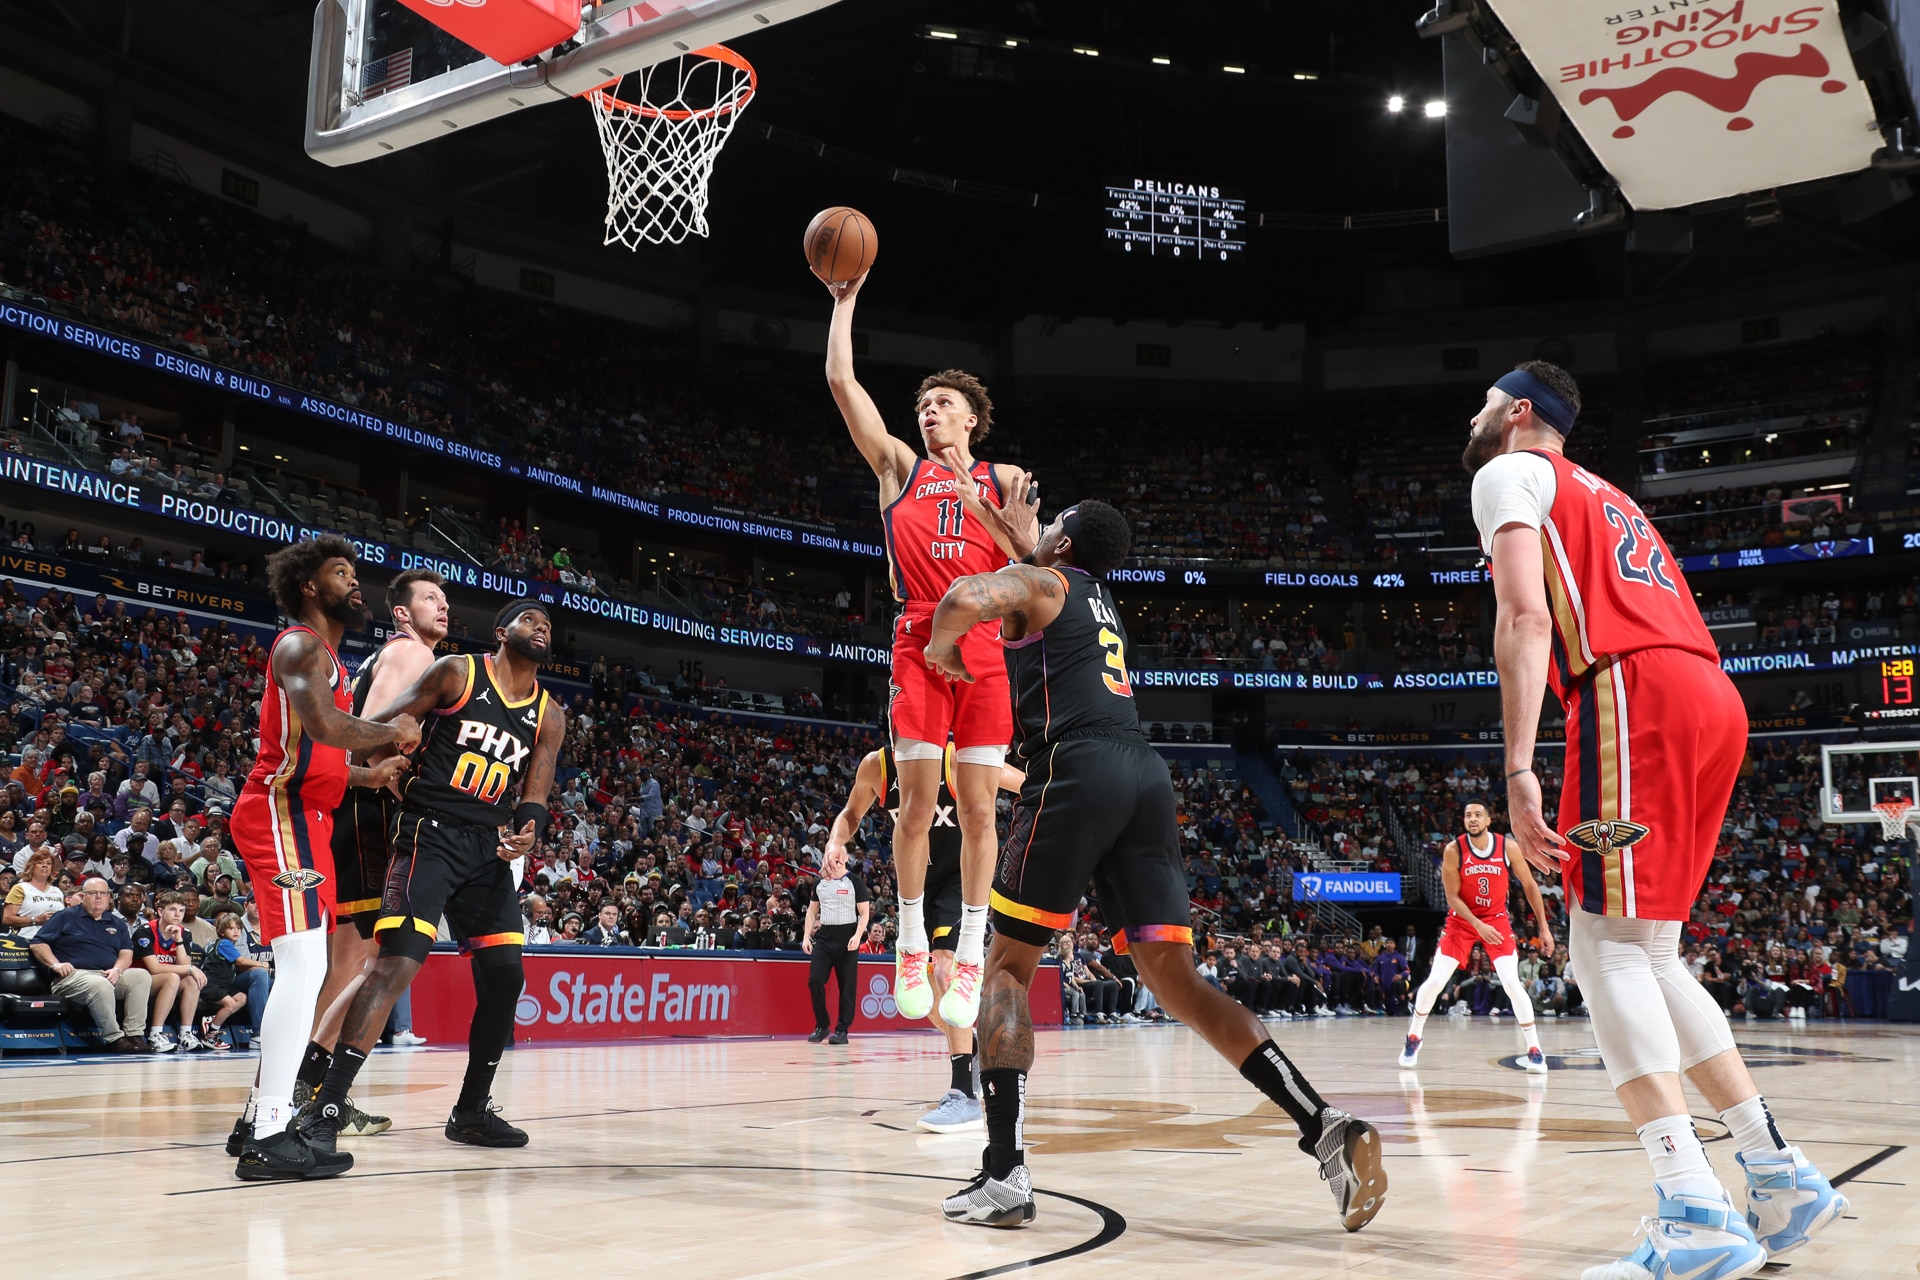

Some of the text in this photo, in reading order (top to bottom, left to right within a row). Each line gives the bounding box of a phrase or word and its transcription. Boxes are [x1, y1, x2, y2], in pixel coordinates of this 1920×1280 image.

[1560, 6, 1824, 83] SMOOTHIE
[1134, 179, 1219, 199] PELICANS
[1119, 199, 1140, 211] 42%
[1169, 204, 1184, 215] 0%
[1213, 208, 1234, 220] 44%
[1124, 221, 1130, 230] 1
[1173, 225, 1180, 235] 4
[1220, 230, 1227, 240] 5
[1124, 242, 1131, 252] 6
[1173, 246, 1180, 256] 0
[1220, 250, 1227, 261] 0
[63, 324, 141, 361] SERVICES
[155, 352, 271, 400] DESIGN & BUILD
[300, 396, 502, 469] ASSOCIATED BUILDING SERVICES
[526, 465, 584, 494] JANITORIAL
[591, 485, 660, 517] MAINTENANCE
[161, 494, 294, 544] PRODUCTION
[668, 508, 794, 542] PRODUCTION SERVICES
[936, 499, 965, 537] 11
[802, 532, 883, 557] DESIGN & BUILD
[931, 541, 966, 559] CITY
[1709, 554, 1720, 568] 4
[1738, 555, 1765, 567] FOULS
[1739, 549, 1762, 559] TEAM
[466, 569, 477, 586] &
[482, 571, 528, 598] BUILD
[1184, 571, 1206, 585] 0%
[1265, 573, 1405, 588] FIELD GOALS 42%
[1430, 570, 1480, 584] THREE
[137, 582, 245, 612] BETRIVERS
[561, 591, 794, 652] ASSOCIATED BUILDING SERVICES
[1711, 608, 1749, 621] CLUB
[828, 643, 893, 665] JANITORI
[1099, 627, 1134, 698] 3
[1718, 653, 1815, 673] ANITORIAL
[1881, 660, 1914, 677] 1:28
[1144, 671, 1219, 687] SERVICES
[1234, 673, 1358, 690] DESIGN & BUILD
[1393, 671, 1499, 689] ASSOCIATED
[1882, 676, 1913, 705] 13
[1430, 702, 1456, 723] 117
[1880, 708, 1920, 718] TISSOT
[456, 719, 530, 772] PHX
[1347, 732, 1430, 743] BETRIVERS
[450, 751, 511, 806] 00
[1464, 863, 1503, 876] CRESCENT
[1325, 879, 1394, 895] FANDUEL
[1477, 876, 1490, 896] 3
[1475, 896, 1492, 908] CITY
